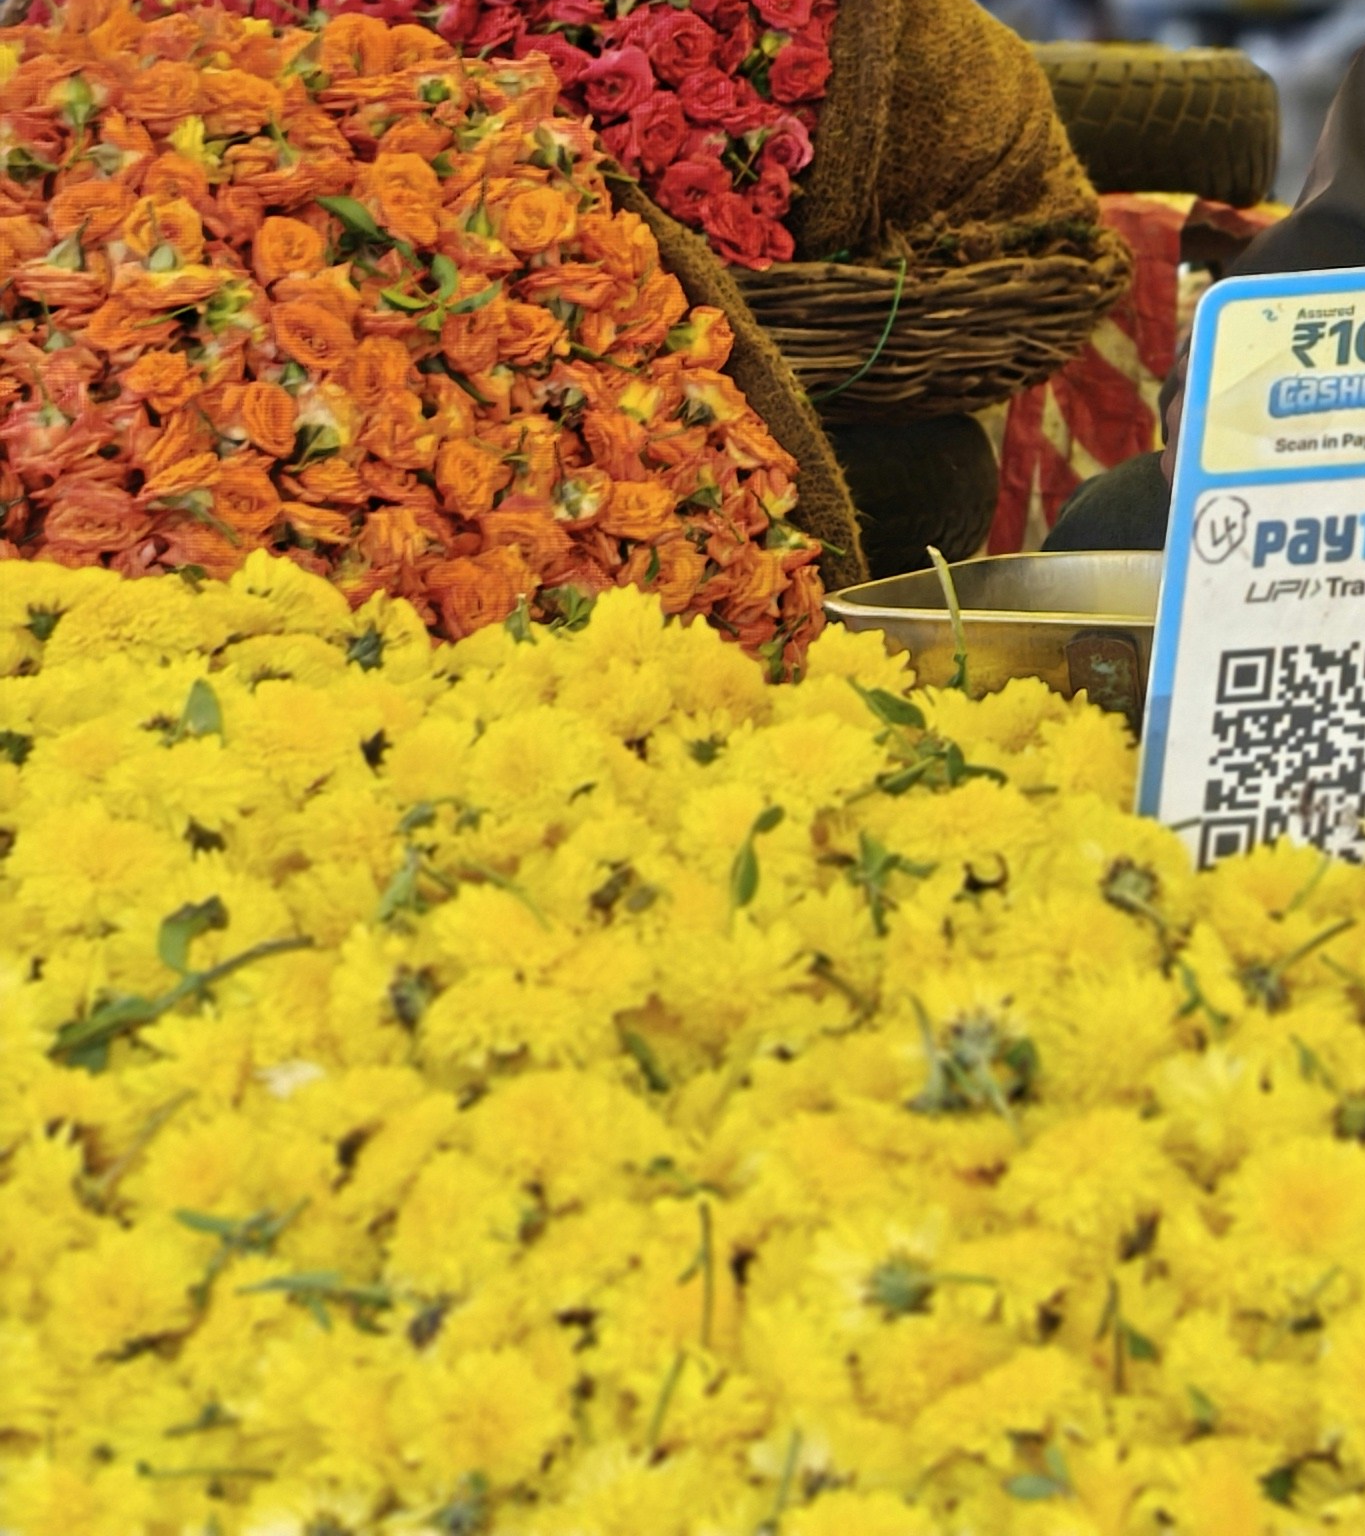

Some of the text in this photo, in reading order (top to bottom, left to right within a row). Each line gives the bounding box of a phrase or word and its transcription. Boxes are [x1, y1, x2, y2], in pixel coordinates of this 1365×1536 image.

[1297, 305, 1354, 320] Assured
[1275, 437, 1318, 453] Scan
[1322, 435, 1338, 450] in
